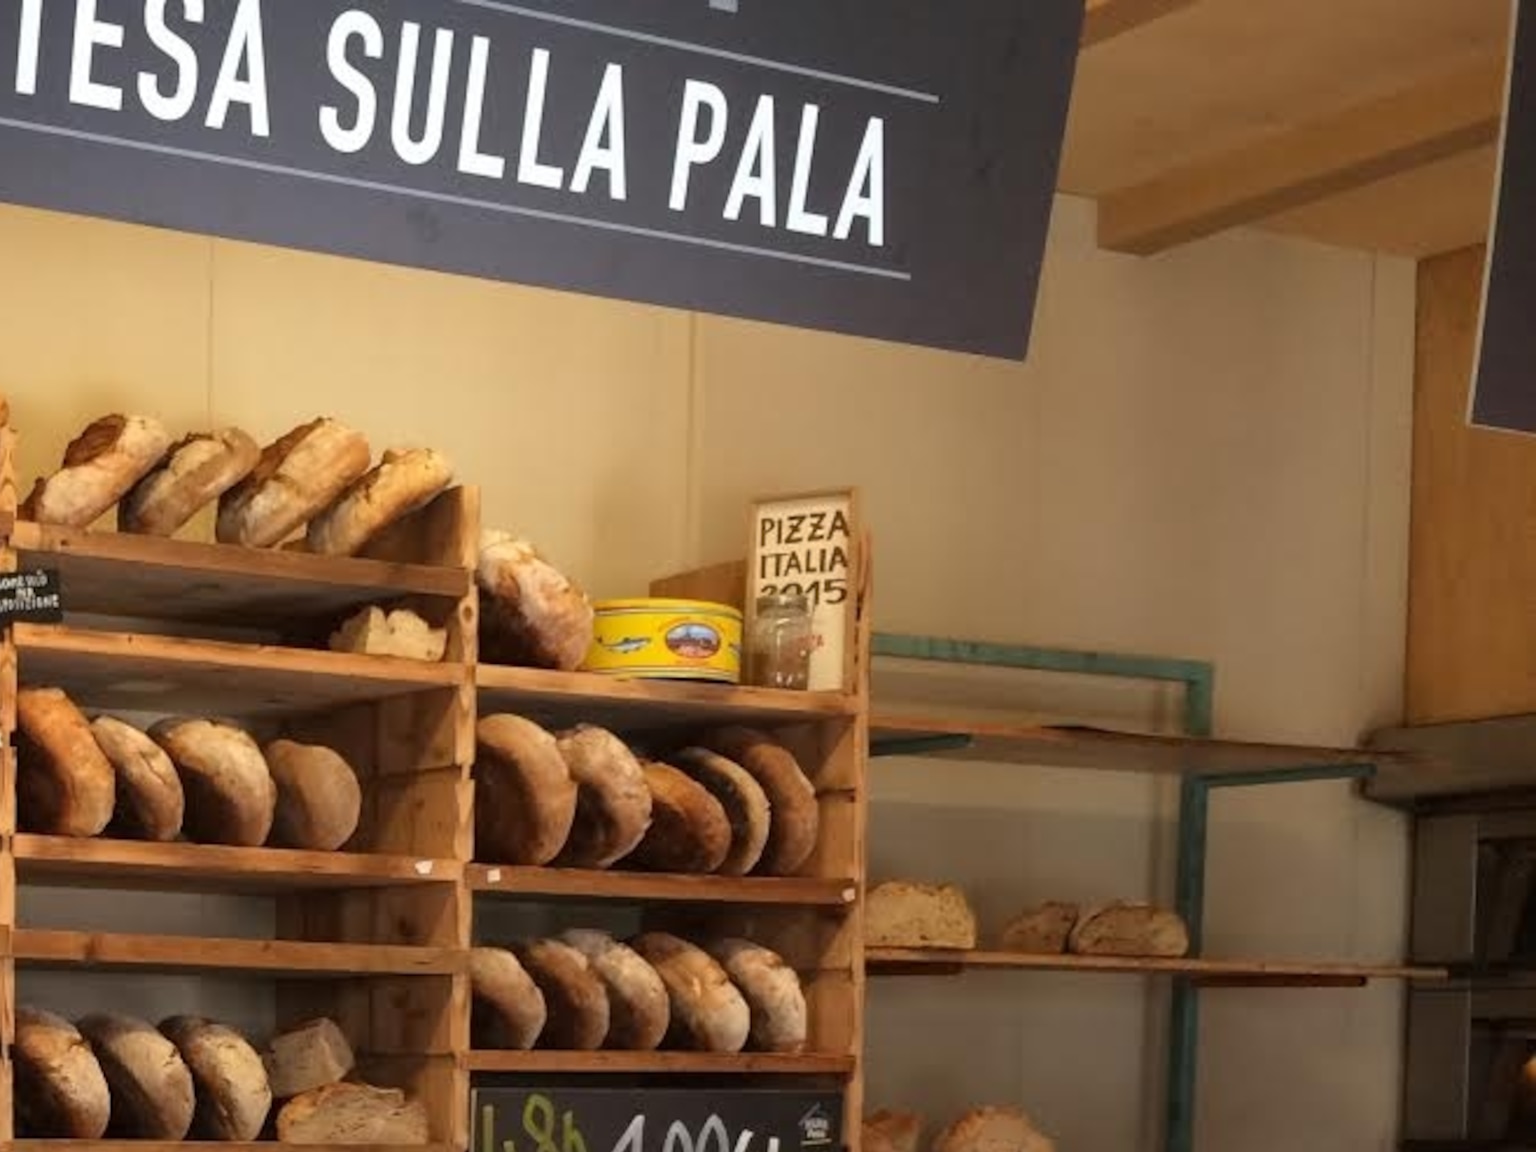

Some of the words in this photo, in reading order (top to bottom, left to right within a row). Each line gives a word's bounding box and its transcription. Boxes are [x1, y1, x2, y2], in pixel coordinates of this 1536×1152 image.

[319, 8, 627, 200] SULLA
[668, 79, 886, 247] PALA
[760, 510, 851, 548] PIZZA
[760, 547, 849, 579] ITALIA
